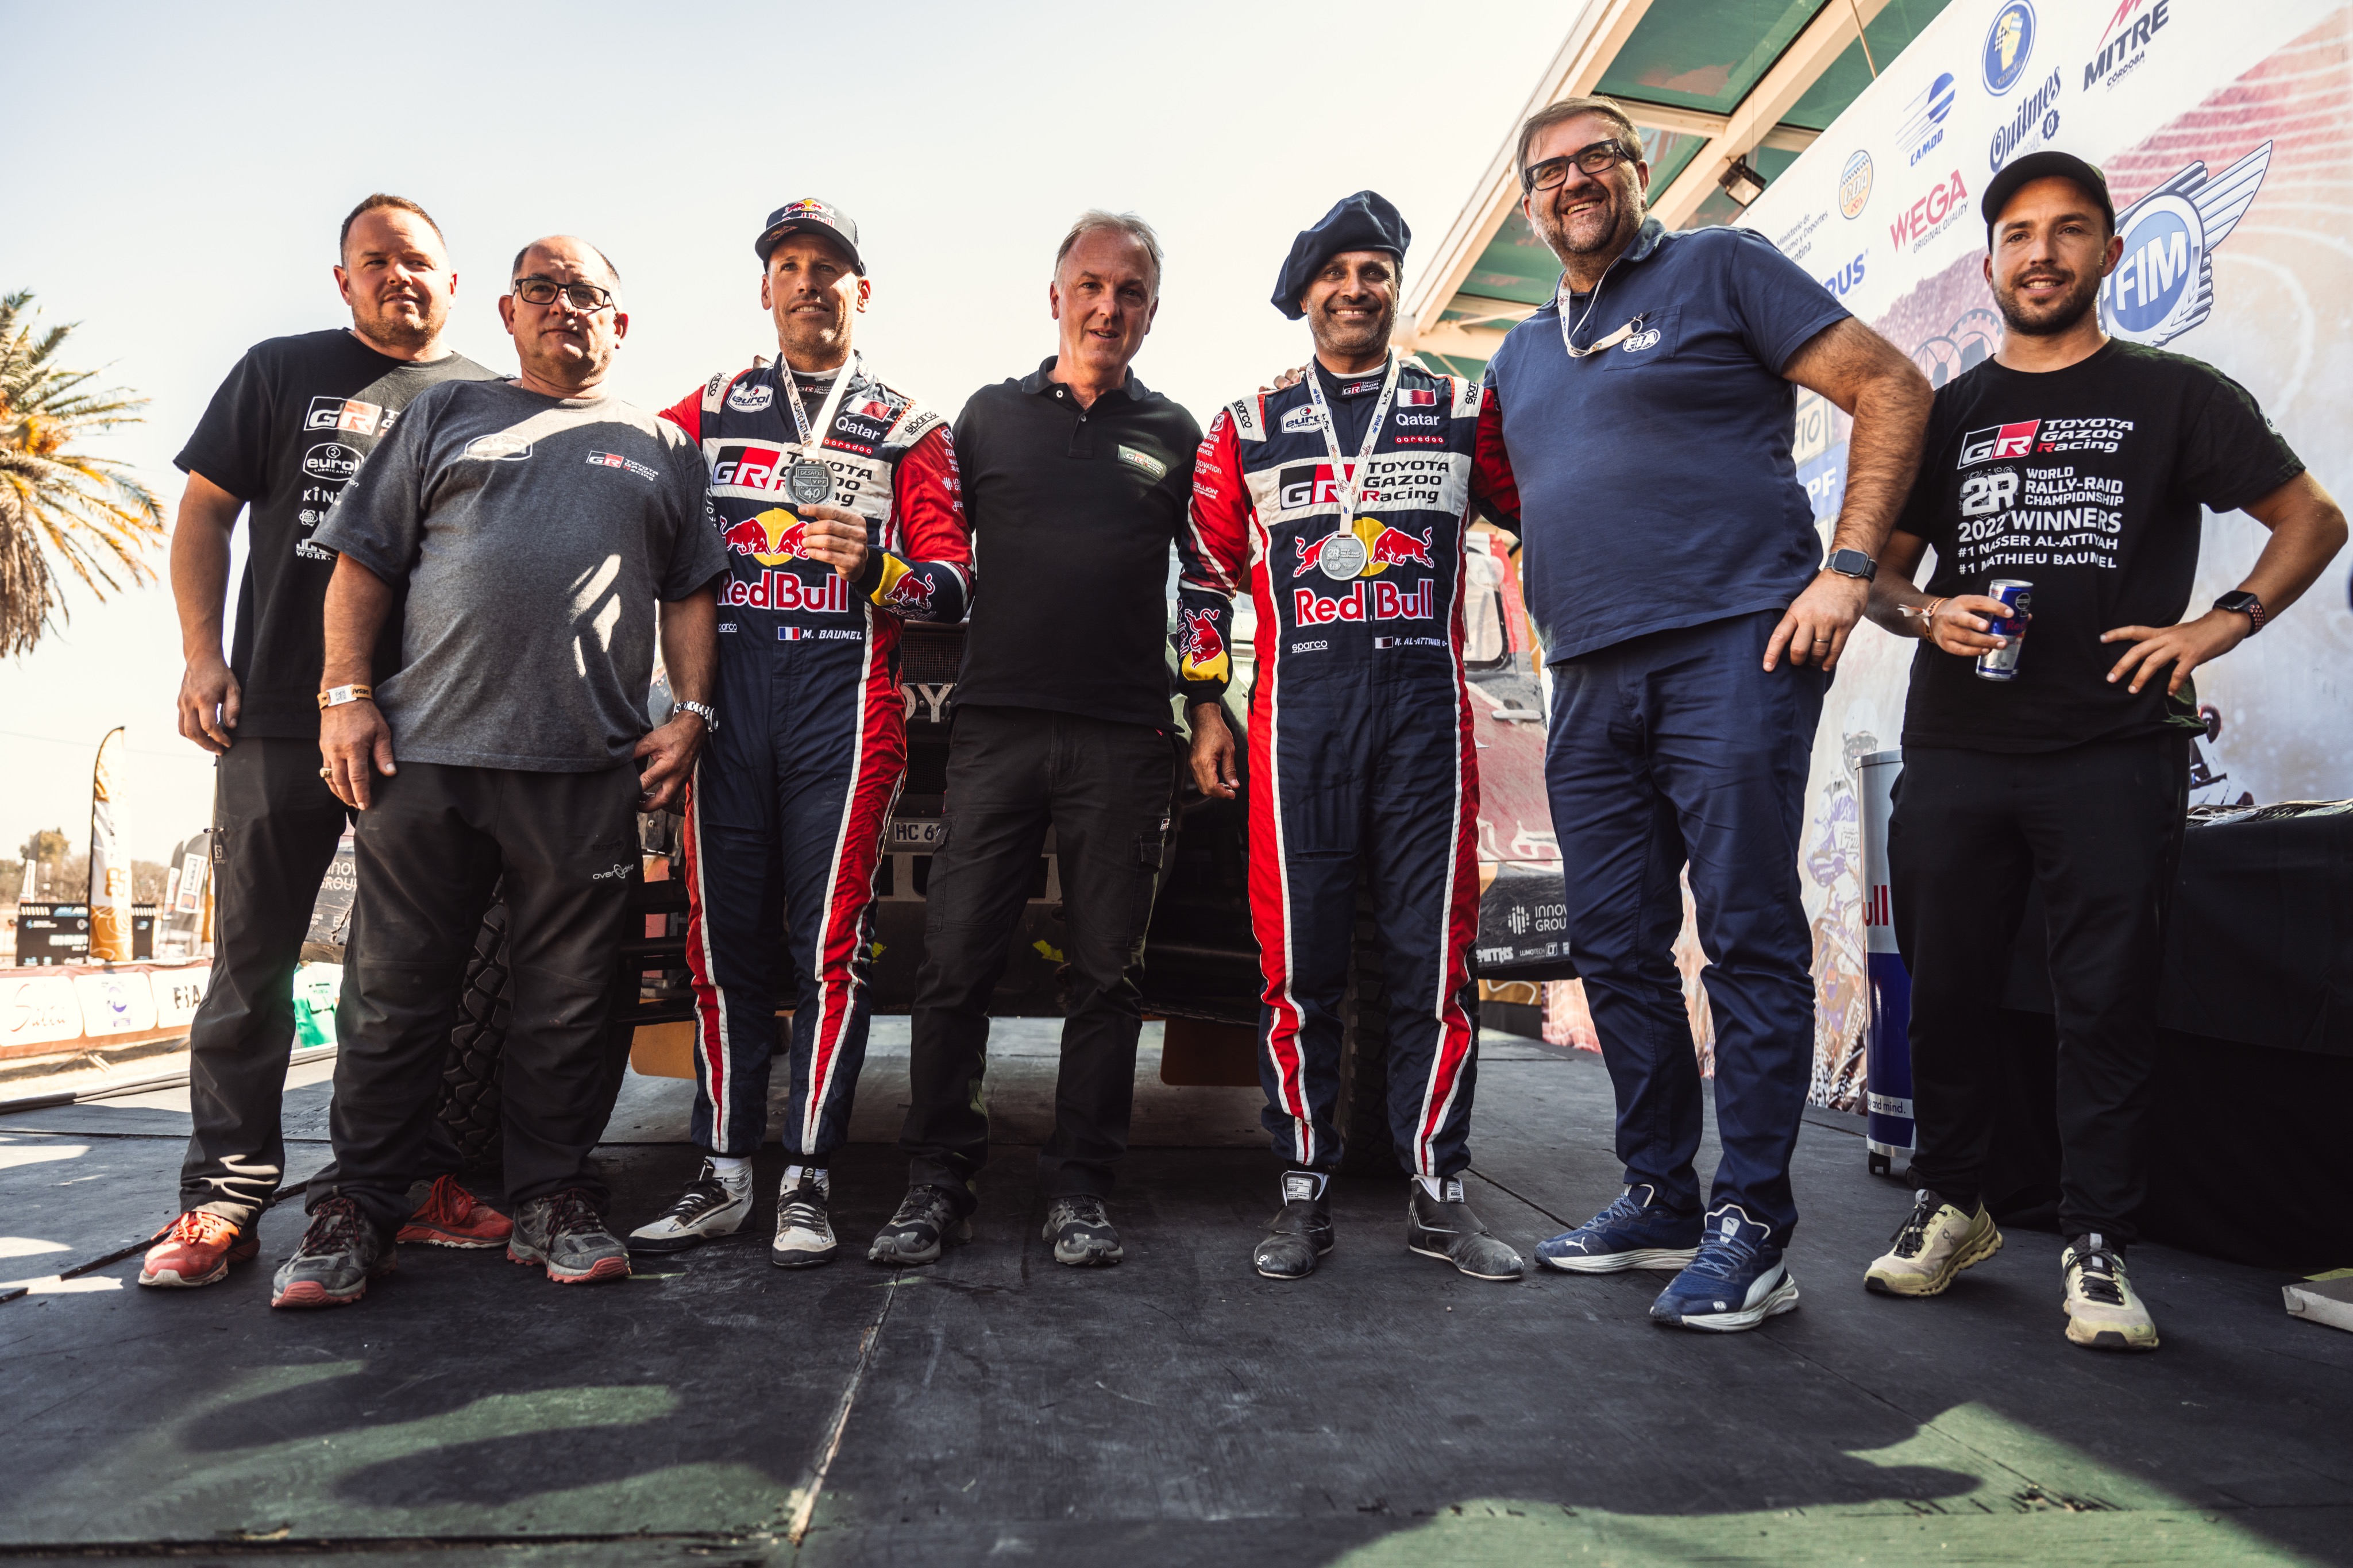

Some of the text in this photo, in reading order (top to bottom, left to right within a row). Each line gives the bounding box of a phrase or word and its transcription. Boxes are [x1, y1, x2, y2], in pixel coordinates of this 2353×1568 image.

[2083, 0, 2169, 92] MITRE
[1990, 65, 2061, 175] Quilmes
[1890, 169, 1968, 253] WEGA
[1776, 213, 1810, 248] Ministerio de
[1782, 240, 1799, 256] rismo
[1803, 210, 1829, 235] Deportes
[1914, 202, 1968, 253] ORIGINAL QUALITY
[2116, 231, 2187, 311] FIM
[732, 393, 770, 405] eurol
[1343, 387, 1361, 395] GR
[1314, 395, 1322, 405] RUS
[308, 409, 374, 432] GR
[904, 411, 940, 436] sparco
[1285, 414, 1321, 428] euro
[1290, 422, 1322, 430] LUBRICANT
[1374, 414, 1383, 426] RUS
[1396, 413, 1440, 426] Qatar
[2045, 418, 2134, 431] TOYOTA
[835, 416, 881, 441] Qatar
[2040, 430, 2124, 442] GAZOO
[824, 438, 873, 455] ooredoo
[1205, 433, 1220, 444] OYOTA
[1395, 435, 1445, 444] ooredoo
[2036, 439, 2119, 453] Racing
[1962, 435, 2032, 465] GR
[307, 458, 362, 472] eurol
[588, 456, 620, 468] GR
[624, 462, 655, 478] GAZOO
[625, 458, 659, 476] TOYOTA
[1367, 461, 1449, 474] TOYOTA
[623, 465, 654, 482] Racing
[713, 462, 771, 489] GR
[2026, 466, 2074, 480] WORLD
[1363, 475, 1442, 488] GAZOO
[2025, 477, 2123, 494] RALLY-RAID
[804, 488, 821, 499] 40
[1361, 488, 1439, 504] Racing
[1962, 472, 2019, 516] 2R
[2024, 491, 2124, 507] CHAMPIONSHIP
[1958, 508, 2123, 543] 2022 WINNERS
[1958, 533, 2118, 558] #1 NASSER AL-ATTIYAH
[1958, 562, 1976, 575] #1
[1981, 553, 2047, 571] MATHIEU
[718, 570, 848, 612] Red Bull
[1294, 578, 1434, 627] Red Bull
[718, 621, 738, 632] parco
[802, 629, 863, 640] M. BAUMEL
[1292, 640, 1328, 654] sparco
[1395, 638, 1402, 646] N.
[896, 824, 919, 841] HC
[1535, 917, 1567, 932] GROU
[1519, 948, 1545, 956] LUMOTECH
[1872, 1098, 1882, 1110] and
[1883, 1100, 1906, 1114] mind.
